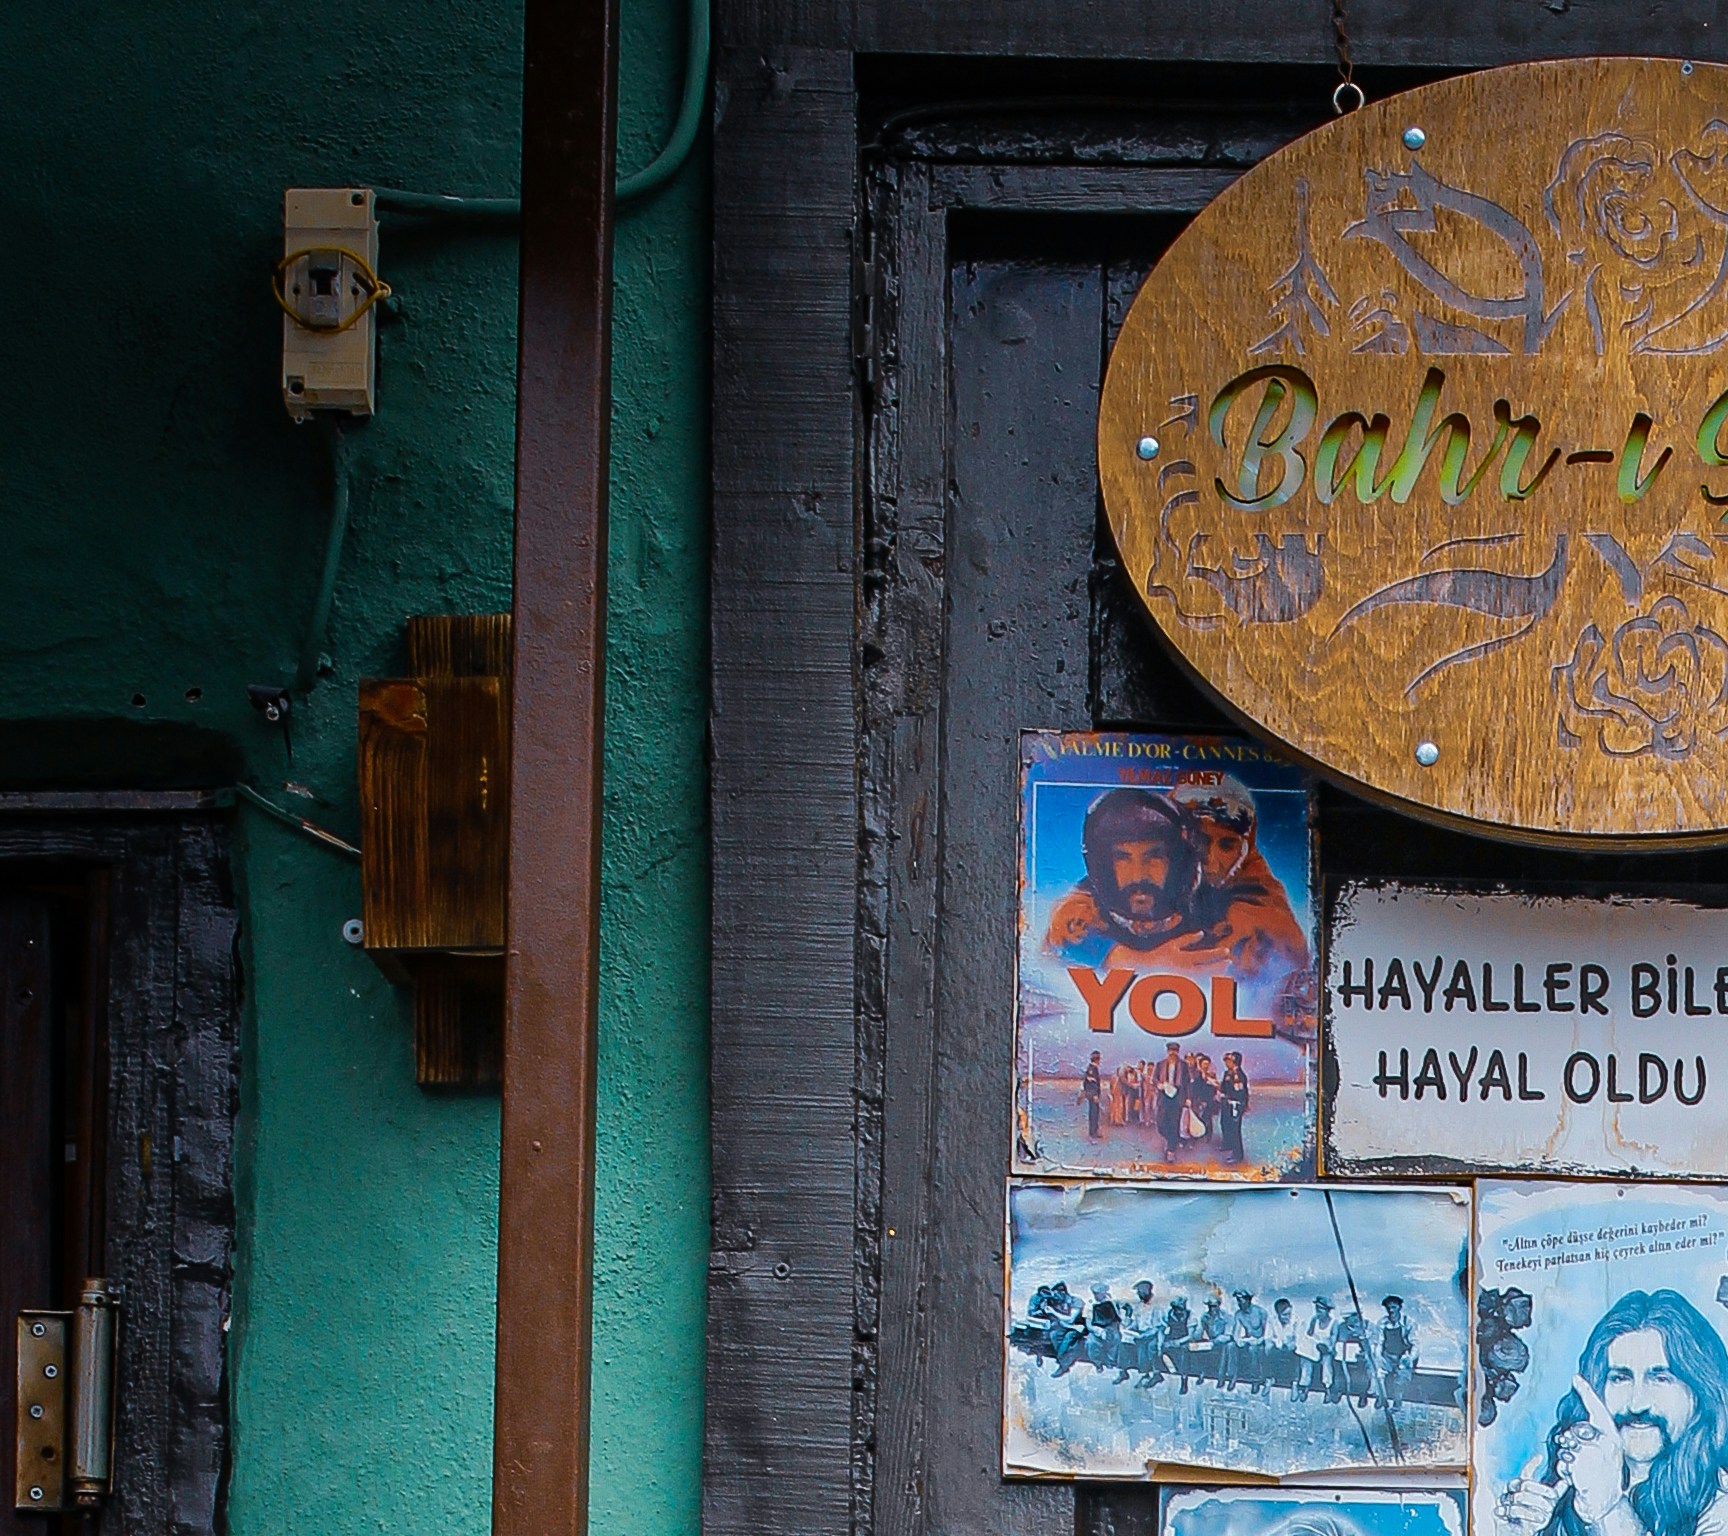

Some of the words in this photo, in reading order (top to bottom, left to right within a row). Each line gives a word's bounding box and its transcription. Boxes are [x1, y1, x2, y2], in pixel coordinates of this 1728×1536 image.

[1067, 967, 1276, 1039] YOL
[1338, 956, 1609, 1015] HAYALLER
[1373, 1045, 1546, 1102] HAYAL
[1563, 1051, 1707, 1106] OLDU
[1495, 1256, 1542, 1272] Tenekeyi
[1544, 1252, 1592, 1270] parlatsan
[1594, 1248, 1610, 1262] hiç
[1613, 1243, 1646, 1260] çeyrek
[1648, 1240, 1673, 1254] altın
[1675, 1237, 1697, 1251] eder
[1540, 1233, 1564, 1250] çöpe
[1567, 1230, 1595, 1246] düşse
[1596, 1223, 1639, 1243] değerini
[1641, 1218, 1687, 1238] kaybeder
[1689, 1214, 1708, 1229] mi?
